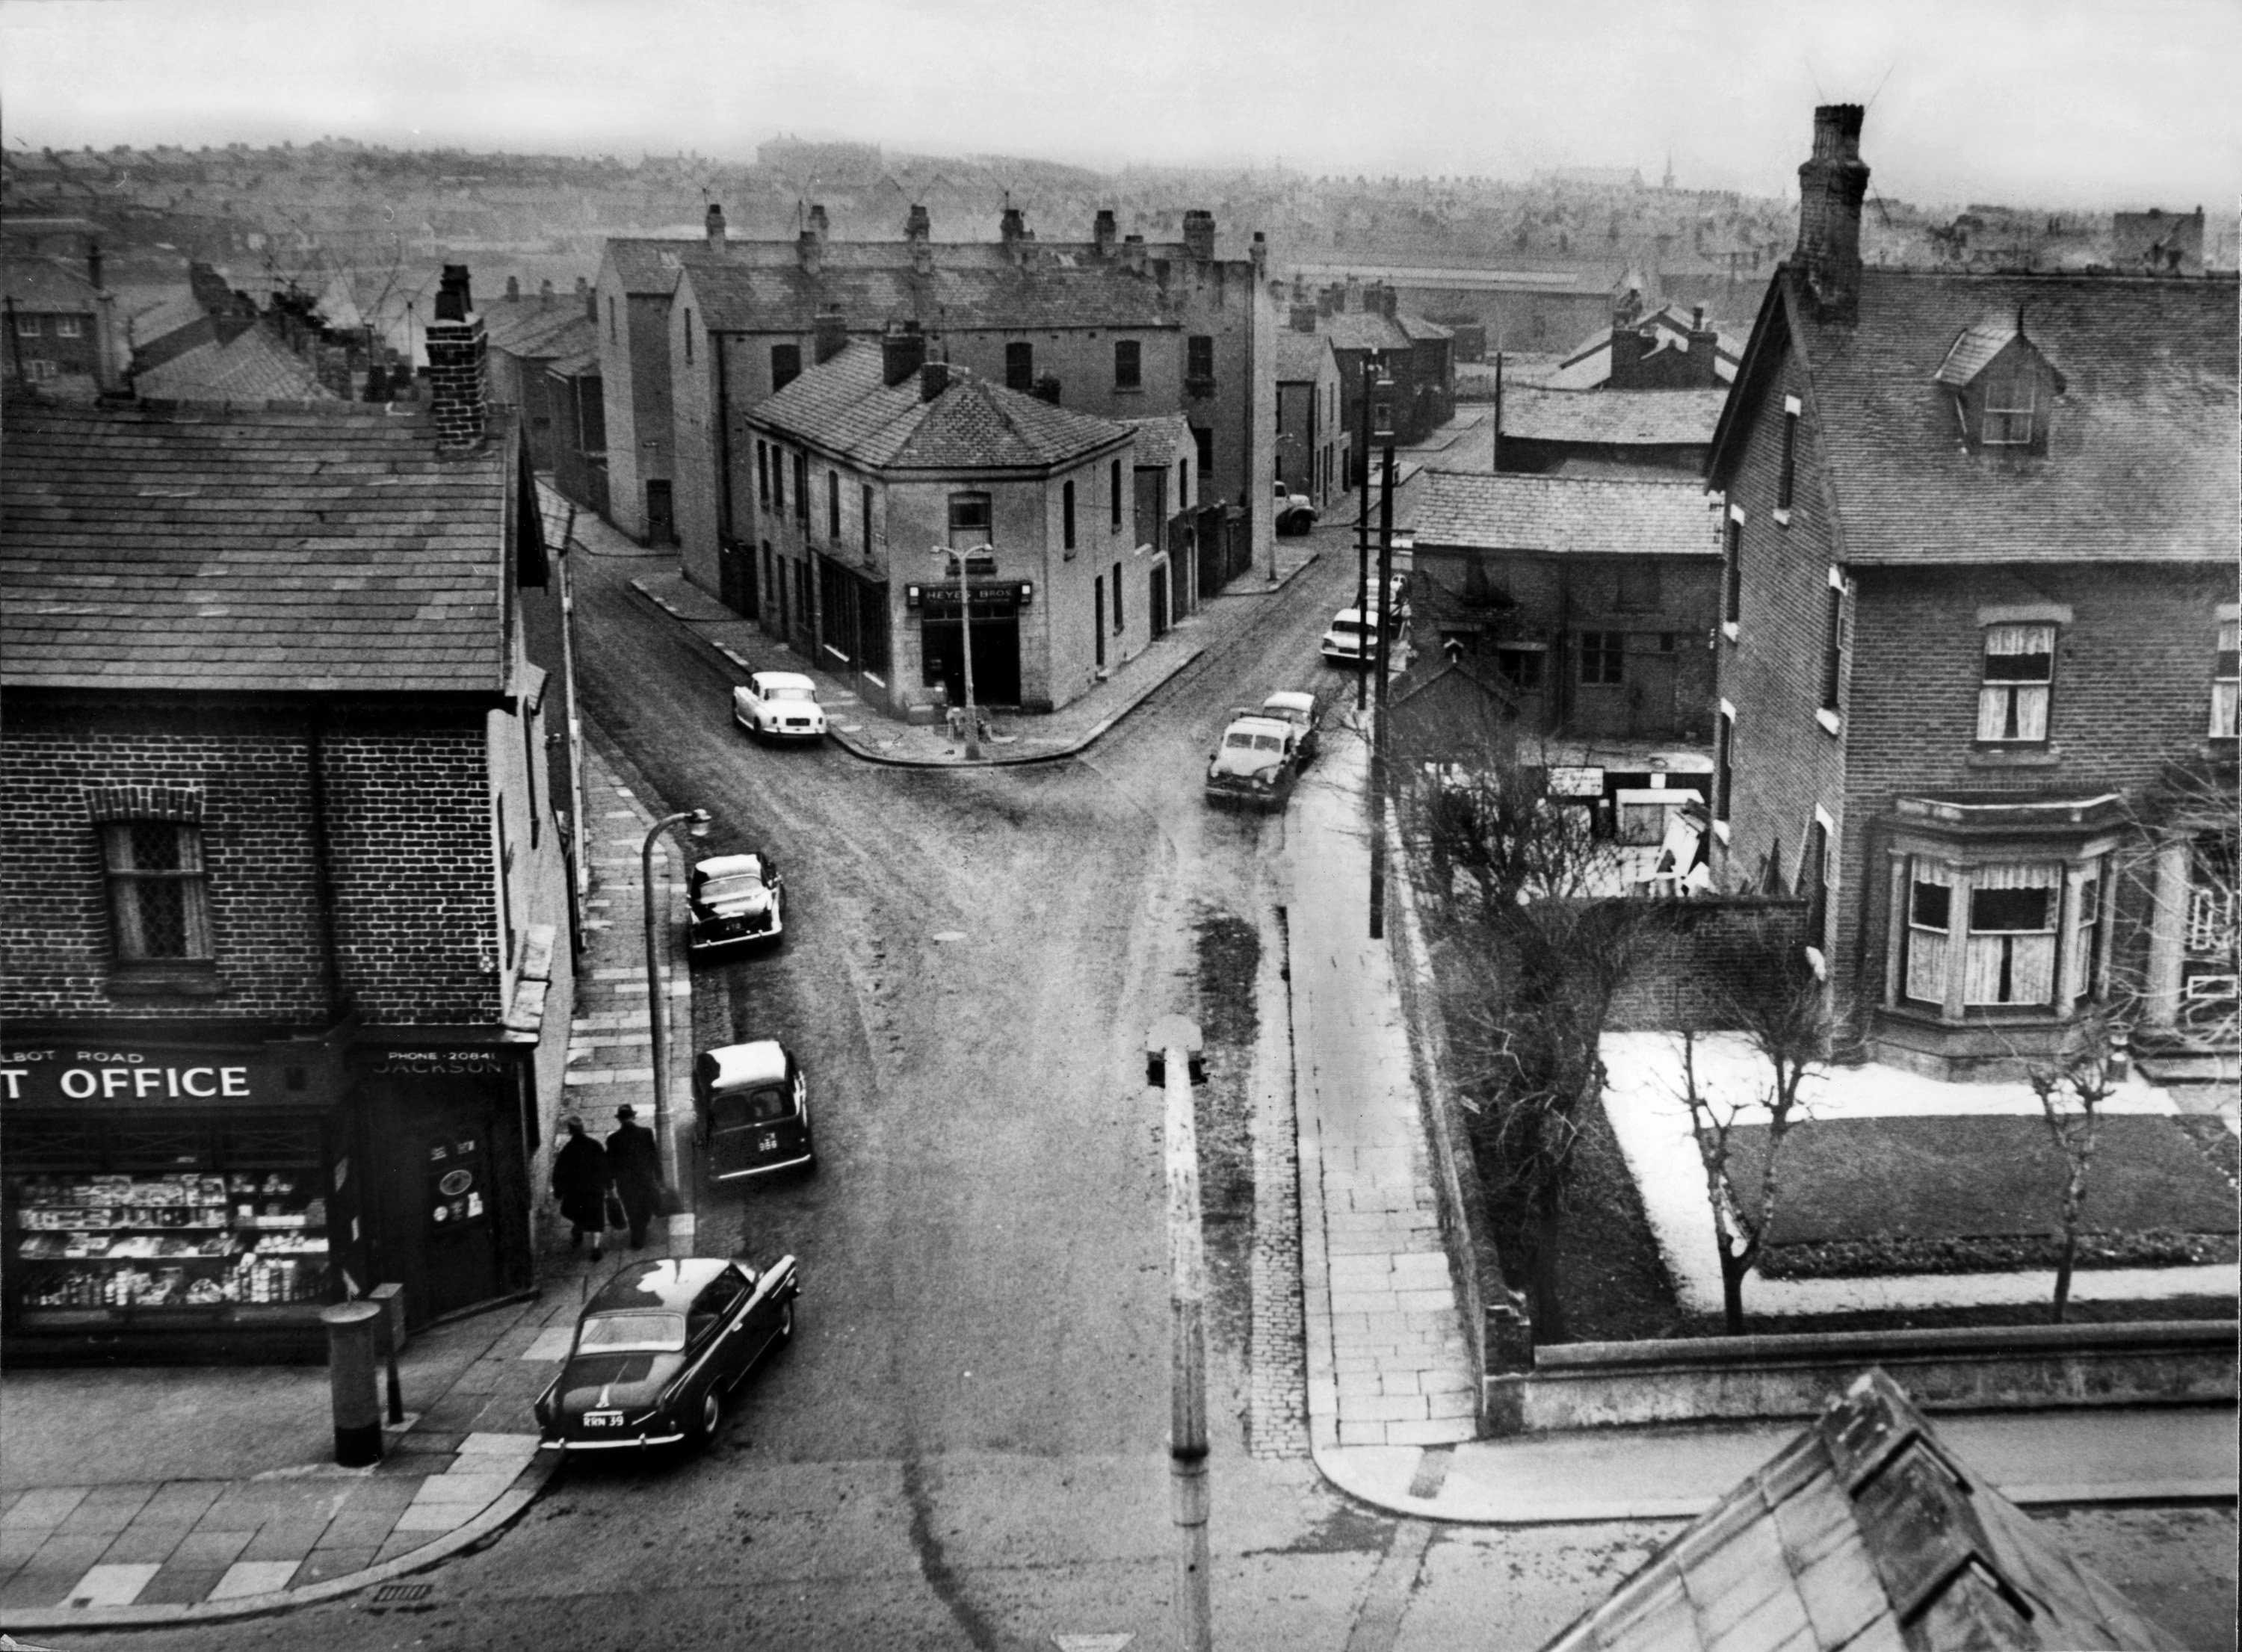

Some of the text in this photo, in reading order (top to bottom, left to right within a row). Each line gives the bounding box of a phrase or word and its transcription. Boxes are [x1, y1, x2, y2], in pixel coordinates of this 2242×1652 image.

[76, 1051, 145, 1063] ROAD
[374, 1062, 501, 1074] JACKSON
[0, 1067, 250, 1098] T OFFICE
[609, 1415, 624, 1426] 39
